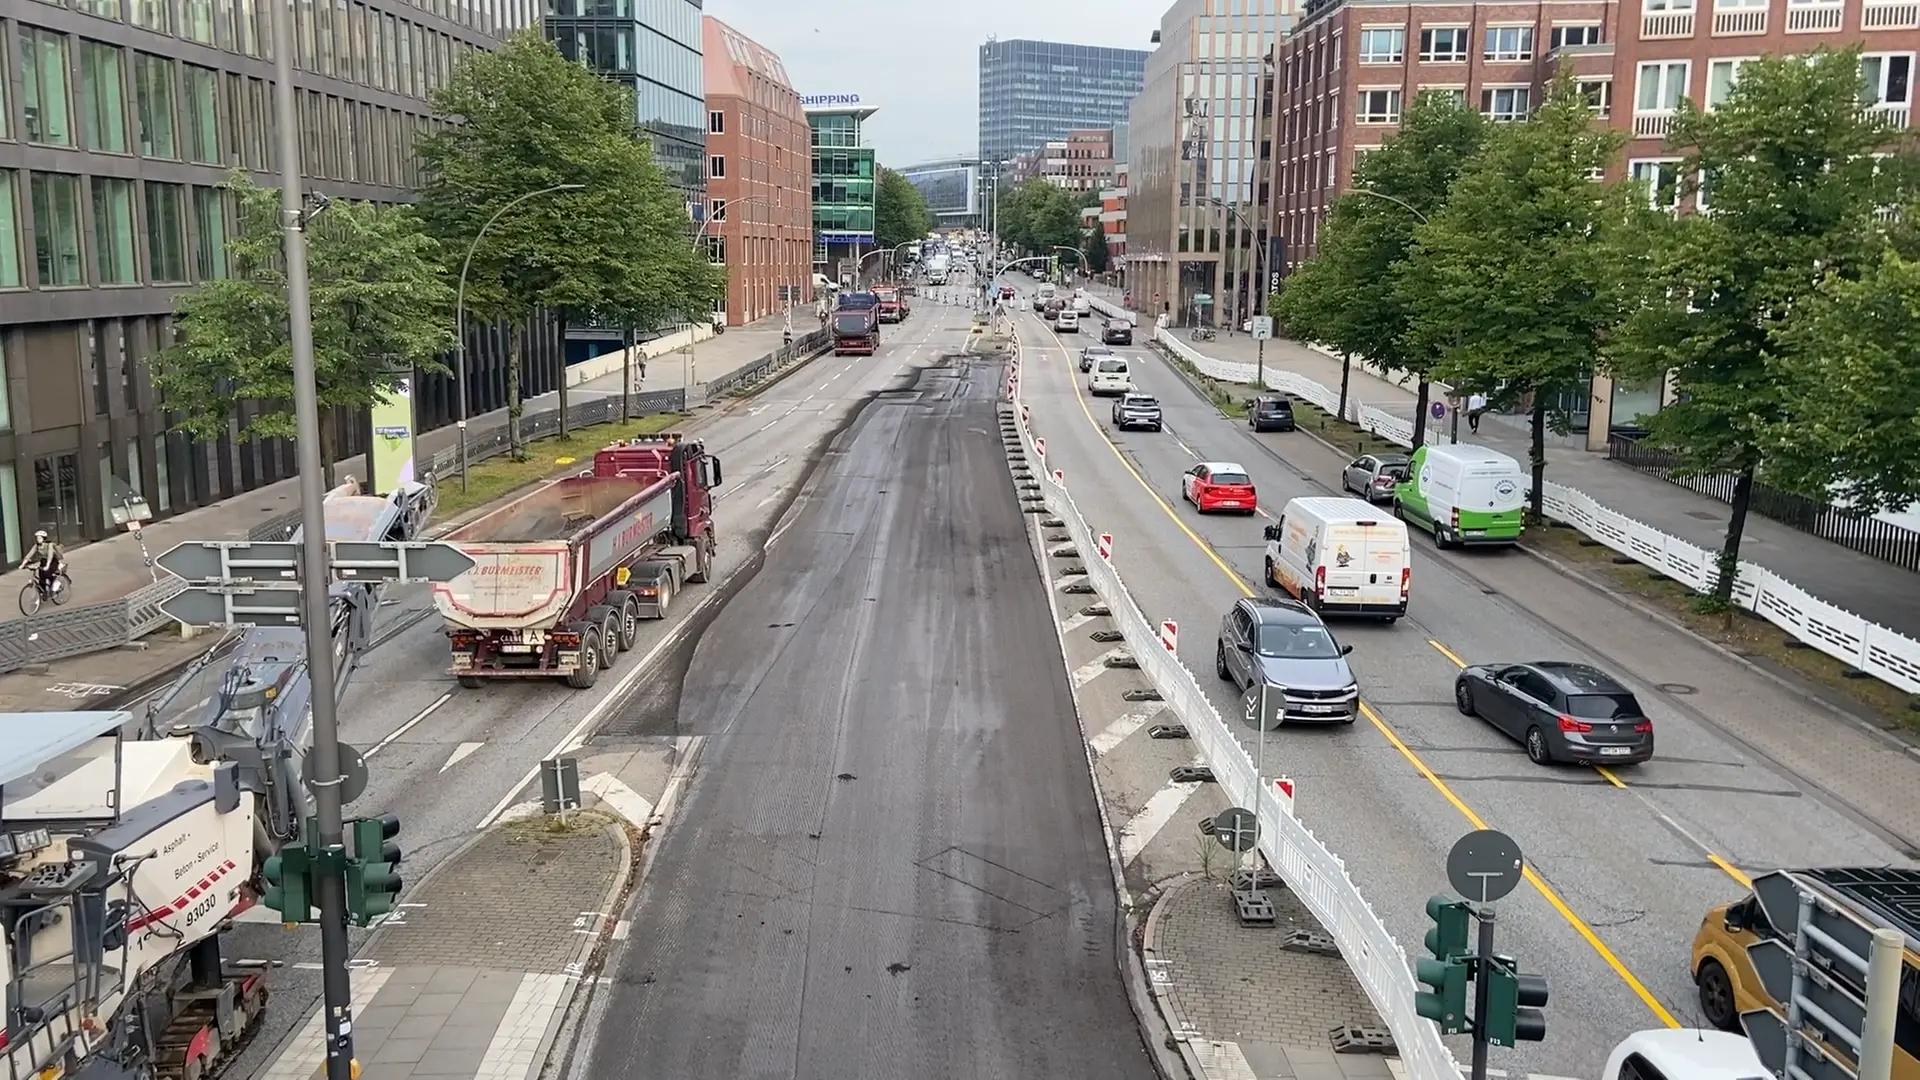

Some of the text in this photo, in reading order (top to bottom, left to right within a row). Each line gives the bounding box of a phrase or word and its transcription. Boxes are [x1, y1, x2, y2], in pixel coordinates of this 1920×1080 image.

[529, 629, 540, 643] A
[163, 833, 187, 856] Asphalt
[197, 842, 220, 864] Service
[186, 894, 216, 927] 93030
